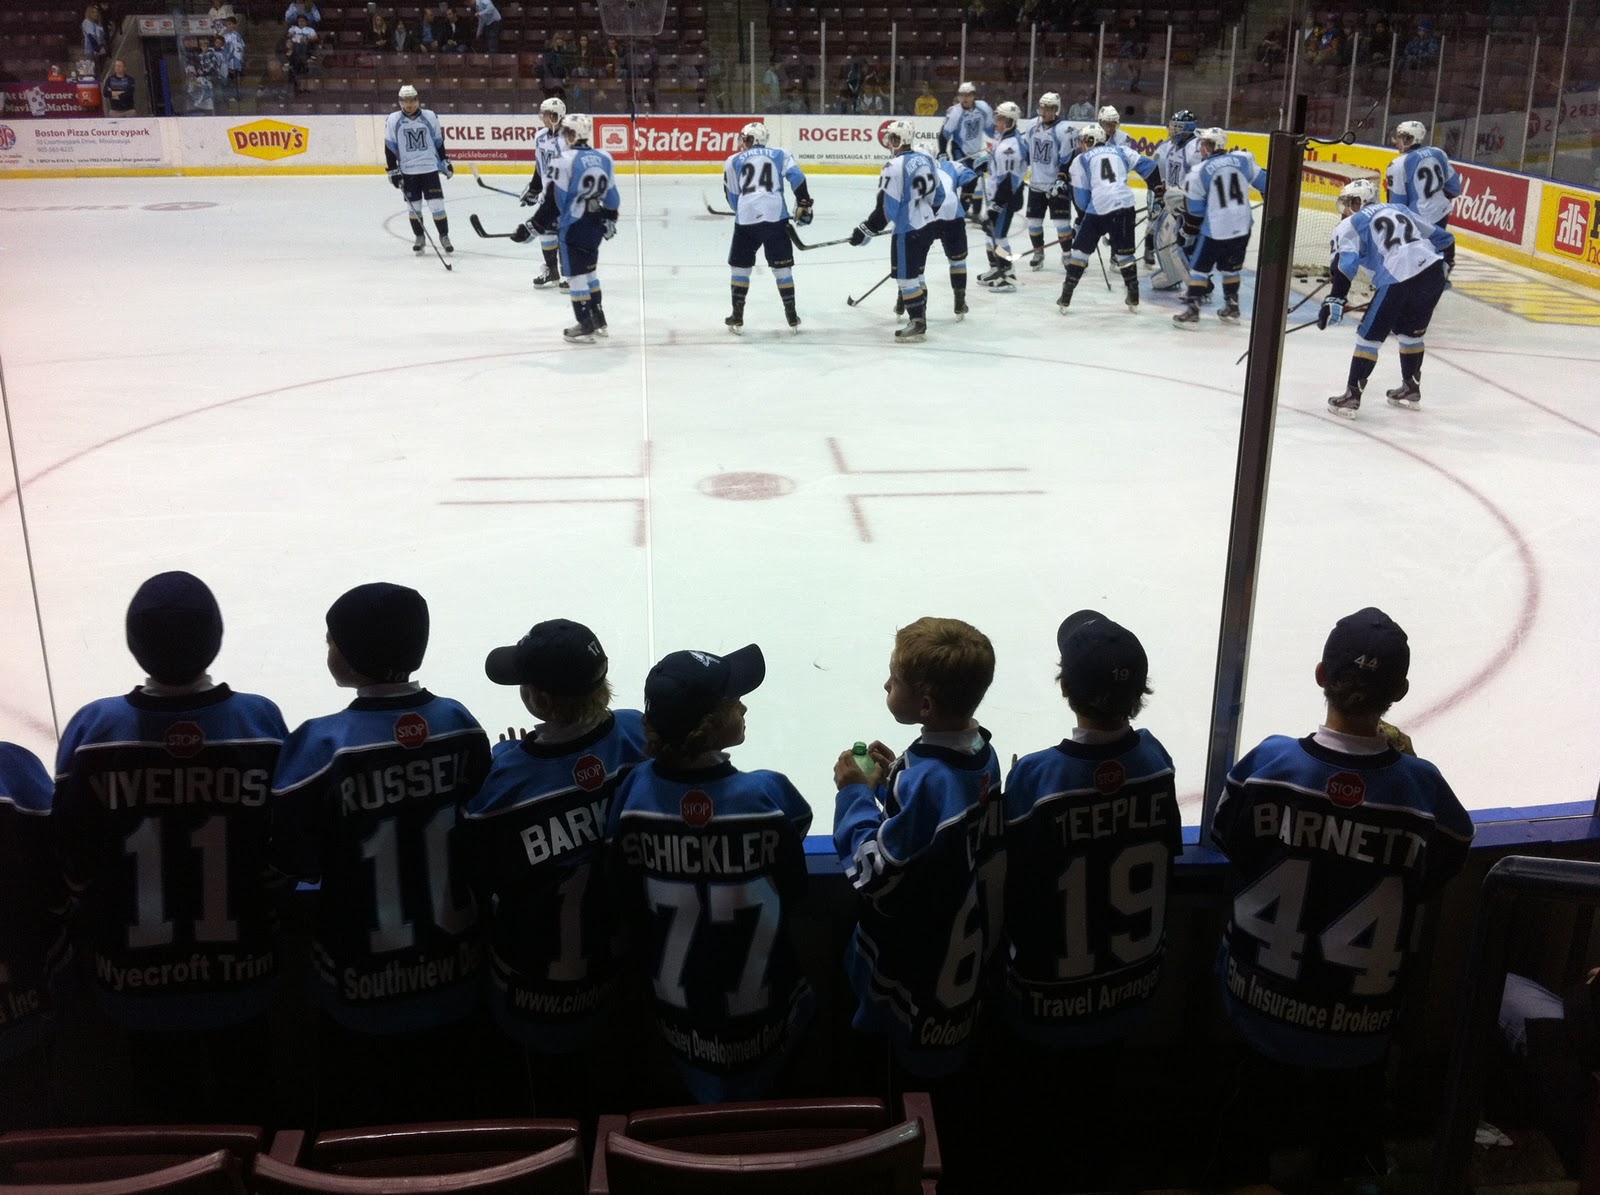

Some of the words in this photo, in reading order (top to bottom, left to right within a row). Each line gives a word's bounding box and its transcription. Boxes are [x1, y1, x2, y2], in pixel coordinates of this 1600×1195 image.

[5, 104, 31, 112] Mavi
[35, 129, 66, 137] Boston
[67, 128, 89, 137] Pizza
[233, 128, 303, 150] Denny's
[404, 128, 428, 152] M
[440, 126, 486, 141] ICKLE
[634, 127, 694, 152] State
[799, 128, 873, 142] ROGERS
[1033, 138, 1053, 164] M
[740, 162, 774, 196] 24
[1101, 157, 1116, 183] 4
[1213, 172, 1245, 208] 14
[1374, 214, 1421, 252] 22
[587, 641, 601, 657] 17
[1112, 668, 1129, 681] 19
[1354, 655, 1379, 670] 44
[168, 733, 199, 747] STOP
[398, 724, 426, 739] STOP
[577, 764, 602, 782] STOP
[1097, 770, 1123, 786] STOP
[1330, 781, 1362, 796] STOP
[683, 803, 710, 816] STOP
[1056, 791, 1169, 848] TEEPLE
[1253, 802, 1427, 869] BARNETT
[621, 829, 781, 875] SCHICKLER
[123, 815, 240, 949] 11
[1056, 840, 1170, 980] 19
[1233, 856, 1406, 996] 44
[643, 874, 781, 1018] 77
[1029, 988, 1093, 1018] Travel
[1248, 974, 1328, 1029] Insurance
